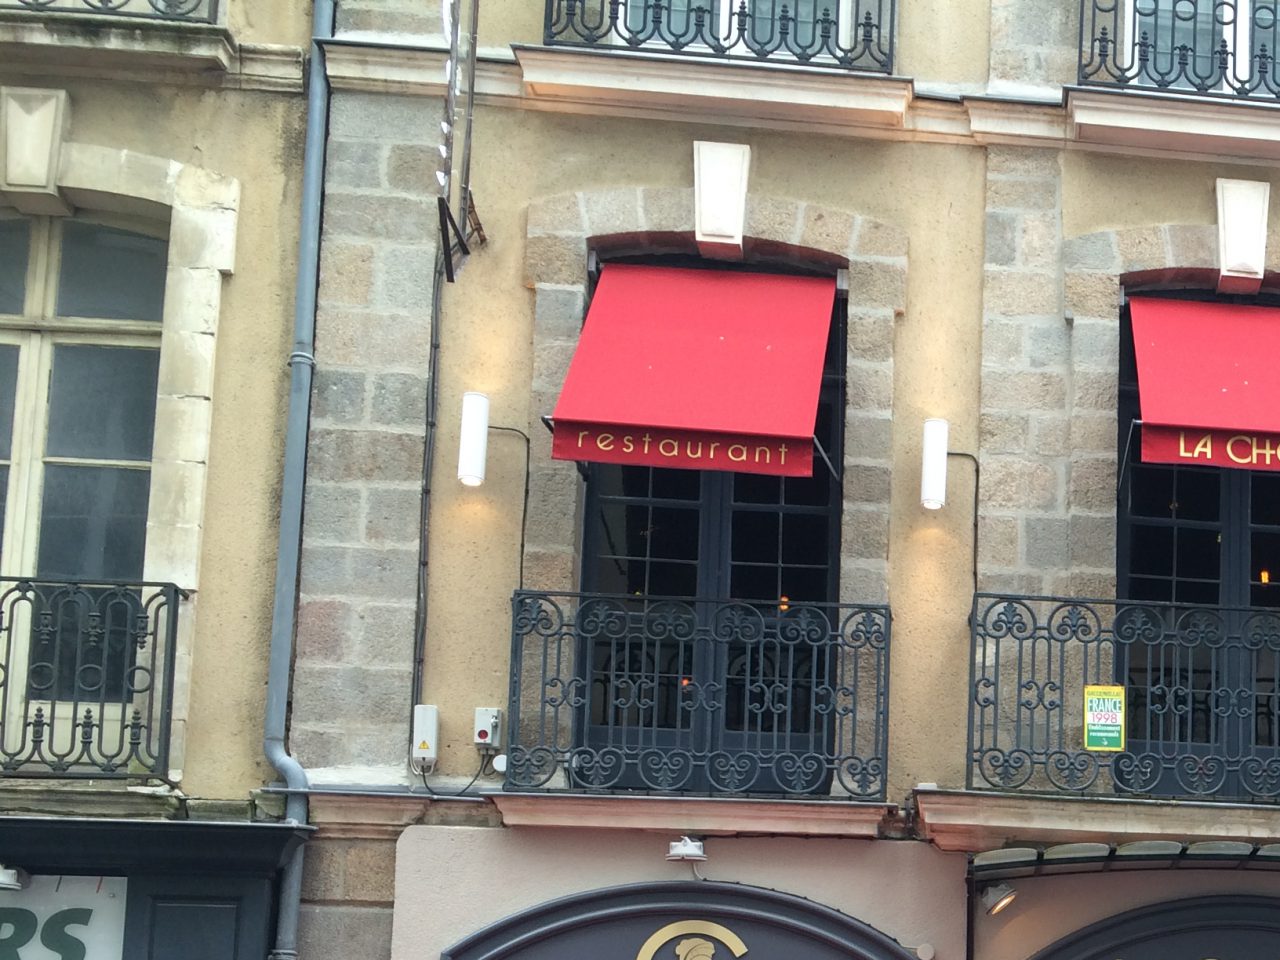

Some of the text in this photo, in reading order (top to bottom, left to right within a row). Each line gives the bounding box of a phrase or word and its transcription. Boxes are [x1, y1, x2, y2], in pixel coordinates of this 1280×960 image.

[577, 430, 789, 465] restaurant
[1179, 431, 1212, 459] LA
[1088, 697, 1122, 713] FRANCE
[1092, 713, 1118, 724] 1998
